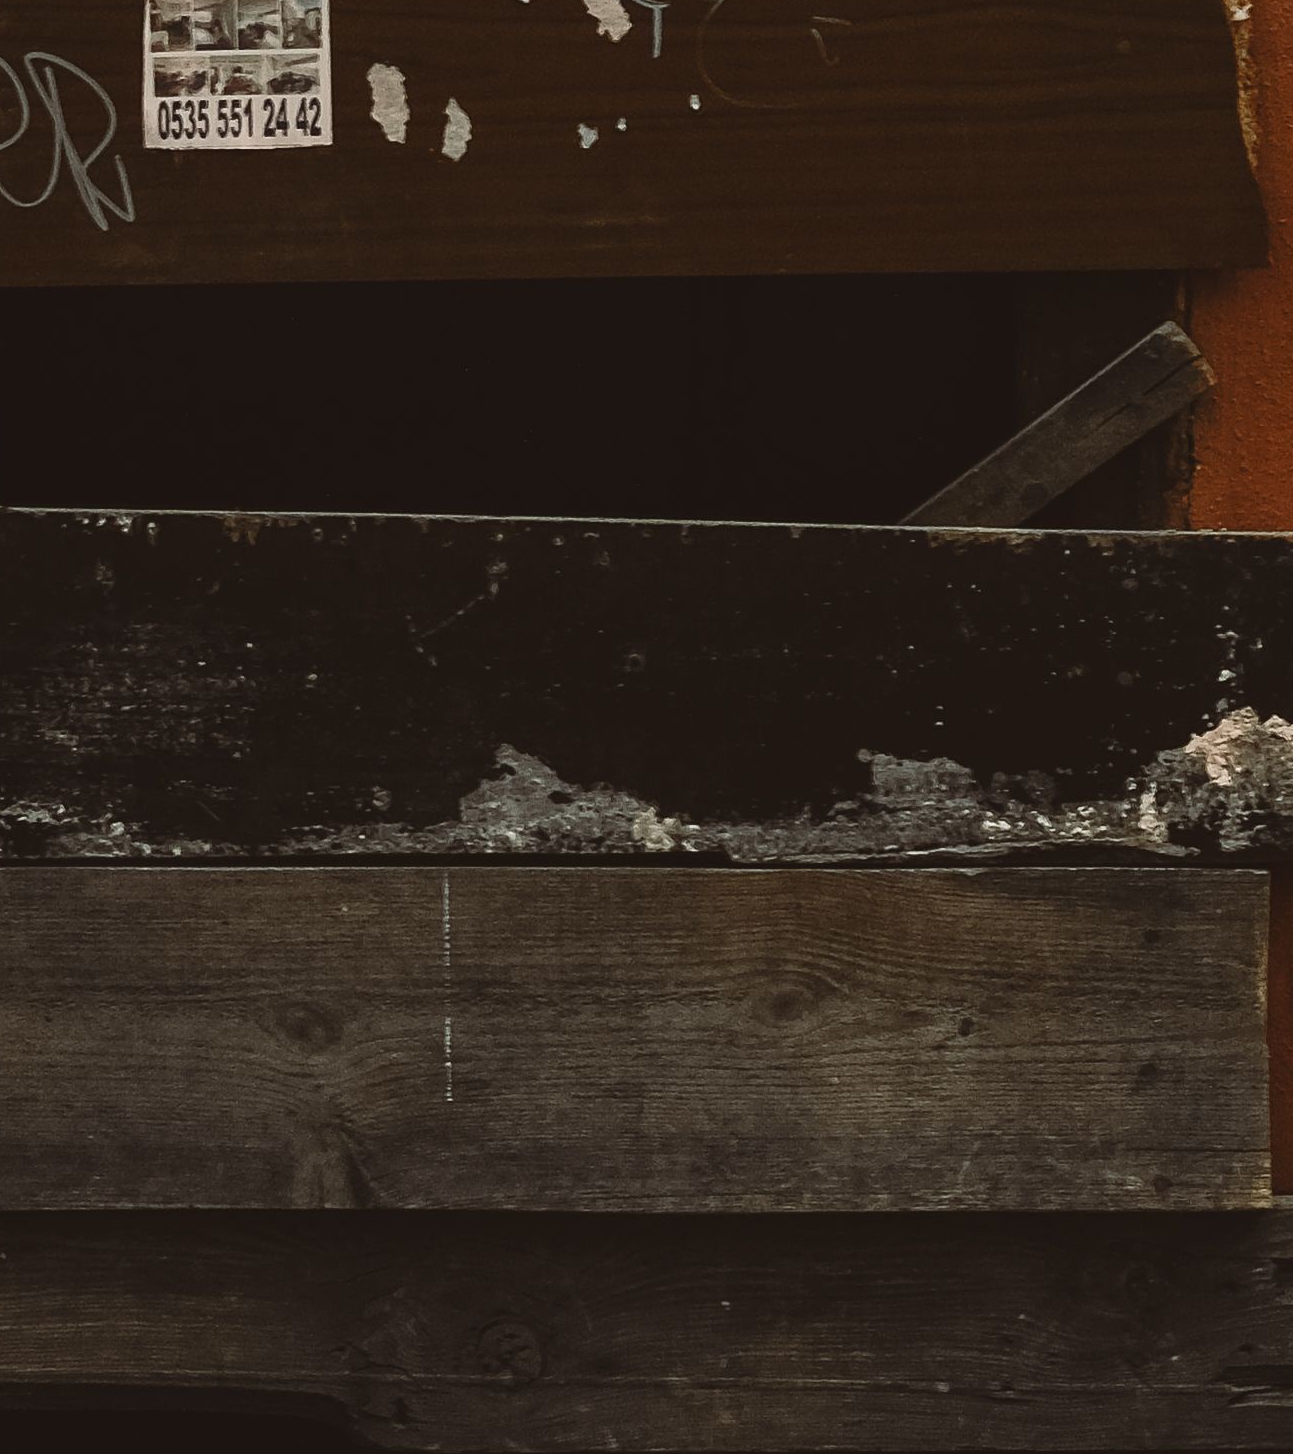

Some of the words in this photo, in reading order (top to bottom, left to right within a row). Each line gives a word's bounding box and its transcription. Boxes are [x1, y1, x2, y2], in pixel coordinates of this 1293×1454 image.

[157, 98, 210, 140] 0535
[217, 98, 254, 139] 551
[263, 97, 290, 138] 24
[296, 97, 323, 138] 42
